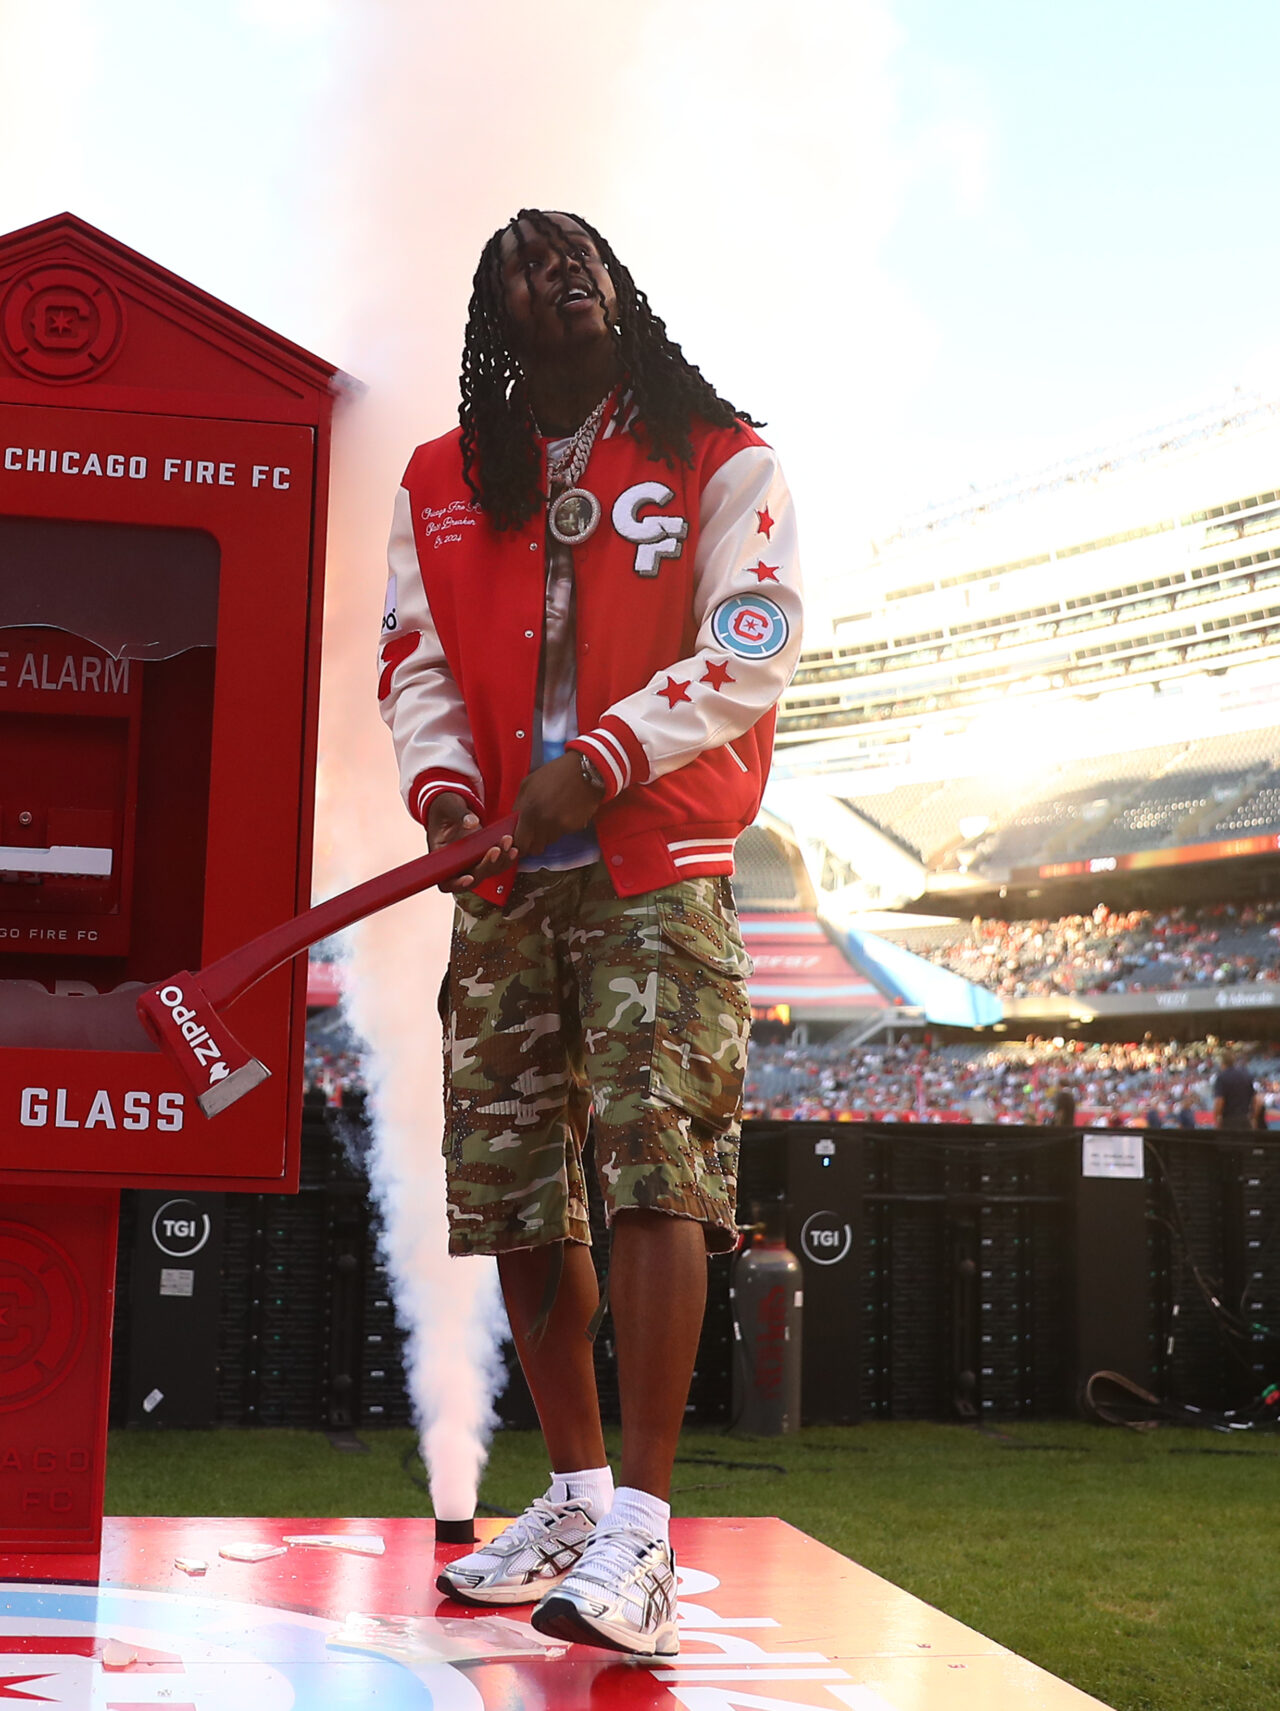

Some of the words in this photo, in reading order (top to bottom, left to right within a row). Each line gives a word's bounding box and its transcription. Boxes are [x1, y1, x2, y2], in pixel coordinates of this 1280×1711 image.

[4, 447, 147, 479] CHICAGO
[163, 458, 236, 486] FIRE
[251, 465, 290, 490] FC
[17, 653, 130, 694] ALARM
[29, 929, 68, 940] FIRE
[77, 931, 98, 941] FC
[157, 985, 221, 1067] ZIPPO
[20, 1087, 185, 1132] GLASS
[163, 1220, 195, 1237] TGI
[810, 1230, 839, 1248] TGI
[23, 1488, 73, 1512] FC
